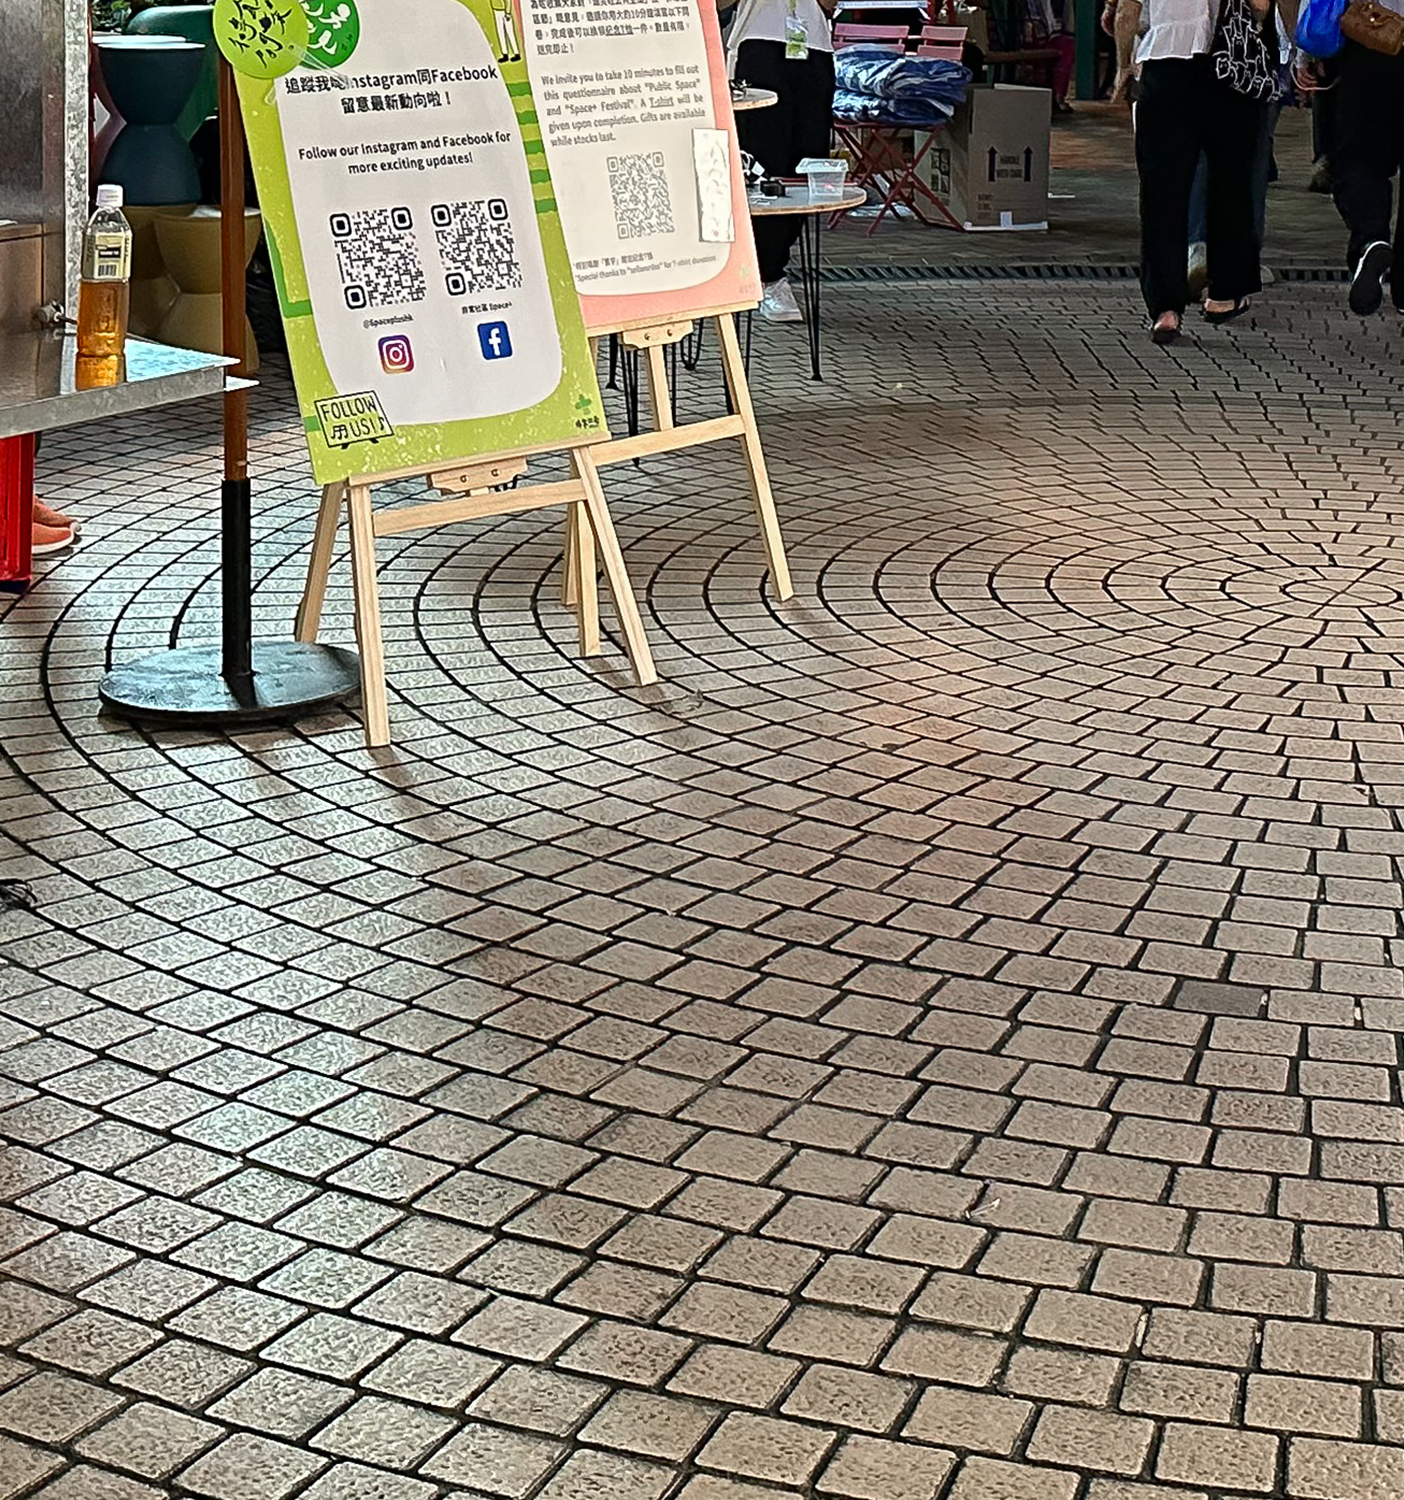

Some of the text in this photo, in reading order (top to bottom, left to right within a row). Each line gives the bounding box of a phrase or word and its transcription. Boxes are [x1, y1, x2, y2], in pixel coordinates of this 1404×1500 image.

[541, 64, 699, 85] We invite you to take 10 minutes to fill out
[341, 91, 452, 114] 留意最新動向啦！
[544, 90, 559, 101] this
[563, 87, 616, 101] questionnaire
[619, 84, 642, 94] about
[546, 105, 562, 116] and
[640, 98, 647, 107] A
[650, 96, 674, 108] T-shirt
[677, 93, 691, 105] will
[694, 93, 703, 103] be
[548, 121, 571, 134] given
[572, 120, 593, 132] upon
[640, 112, 658, 123] Gifts
[659, 112, 672, 121] are
[673, 108, 706, 120] available
[298, 130, 511, 161] Follow our Instagram and Facebook for
[550, 136, 573, 147] while
[573, 134, 599, 145] stocks
[348, 151, 474, 174] more exciting updates!
[320, 395, 377, 422] FOLLOW
